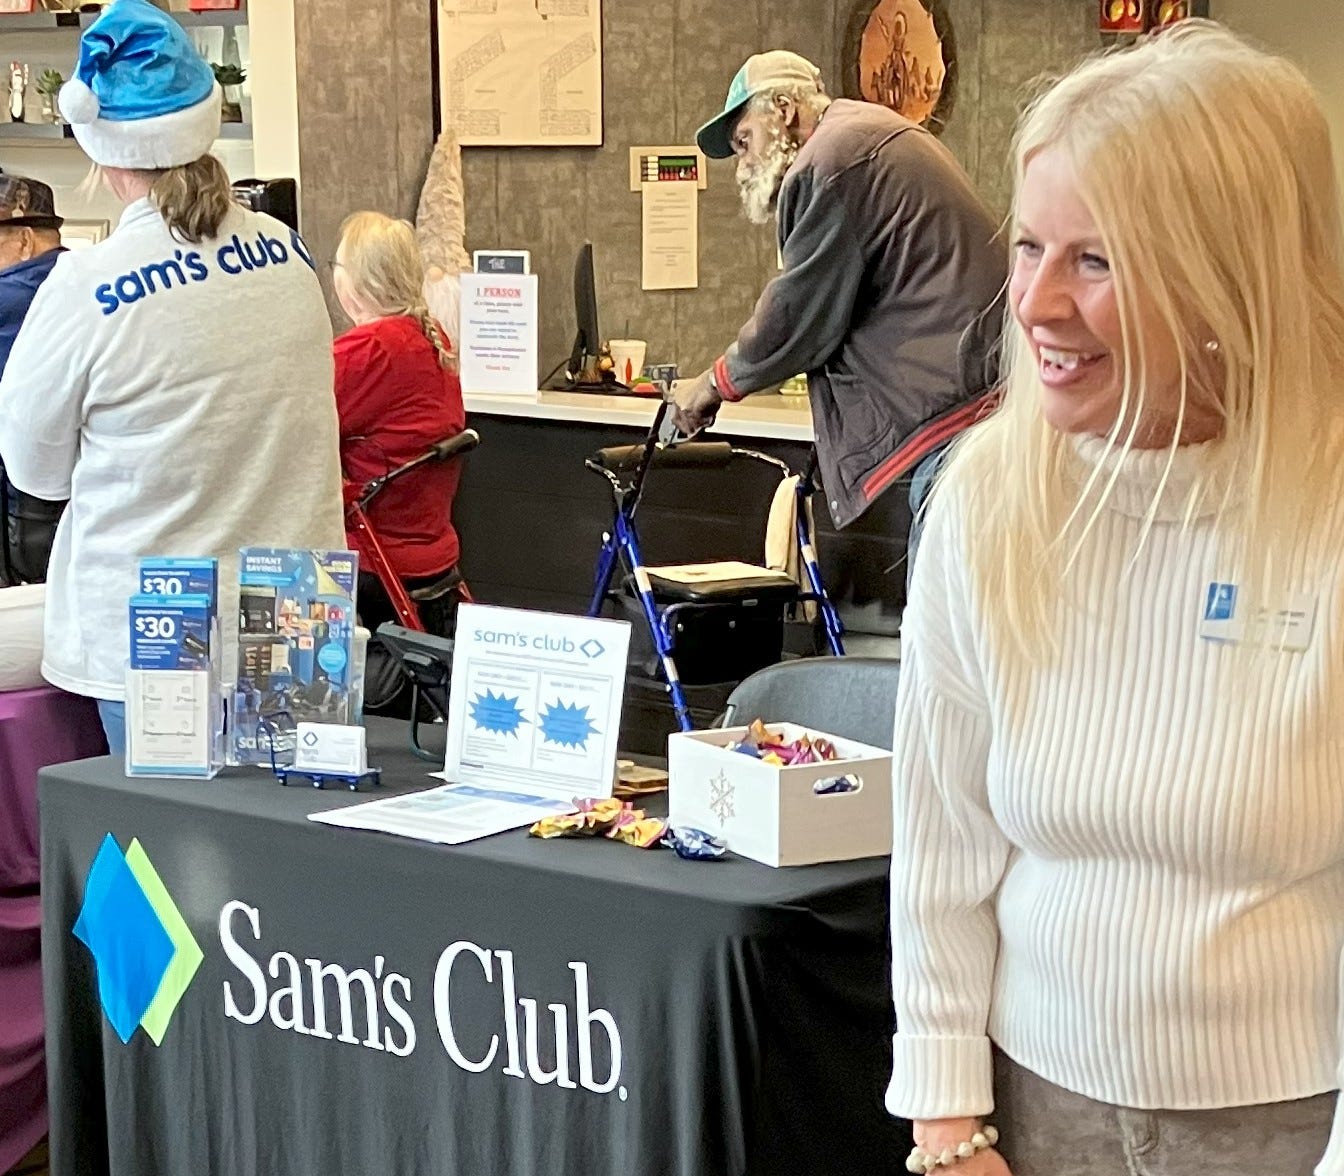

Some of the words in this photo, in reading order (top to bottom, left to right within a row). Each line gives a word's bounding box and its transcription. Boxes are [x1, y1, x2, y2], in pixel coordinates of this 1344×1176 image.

[95, 249, 208, 316] sam's
[216, 232, 288, 275] club
[135, 615, 176, 638] $30
[473, 628, 528, 648] sam's
[532, 635, 576, 653] club
[219, 899, 416, 1057] Sam's
